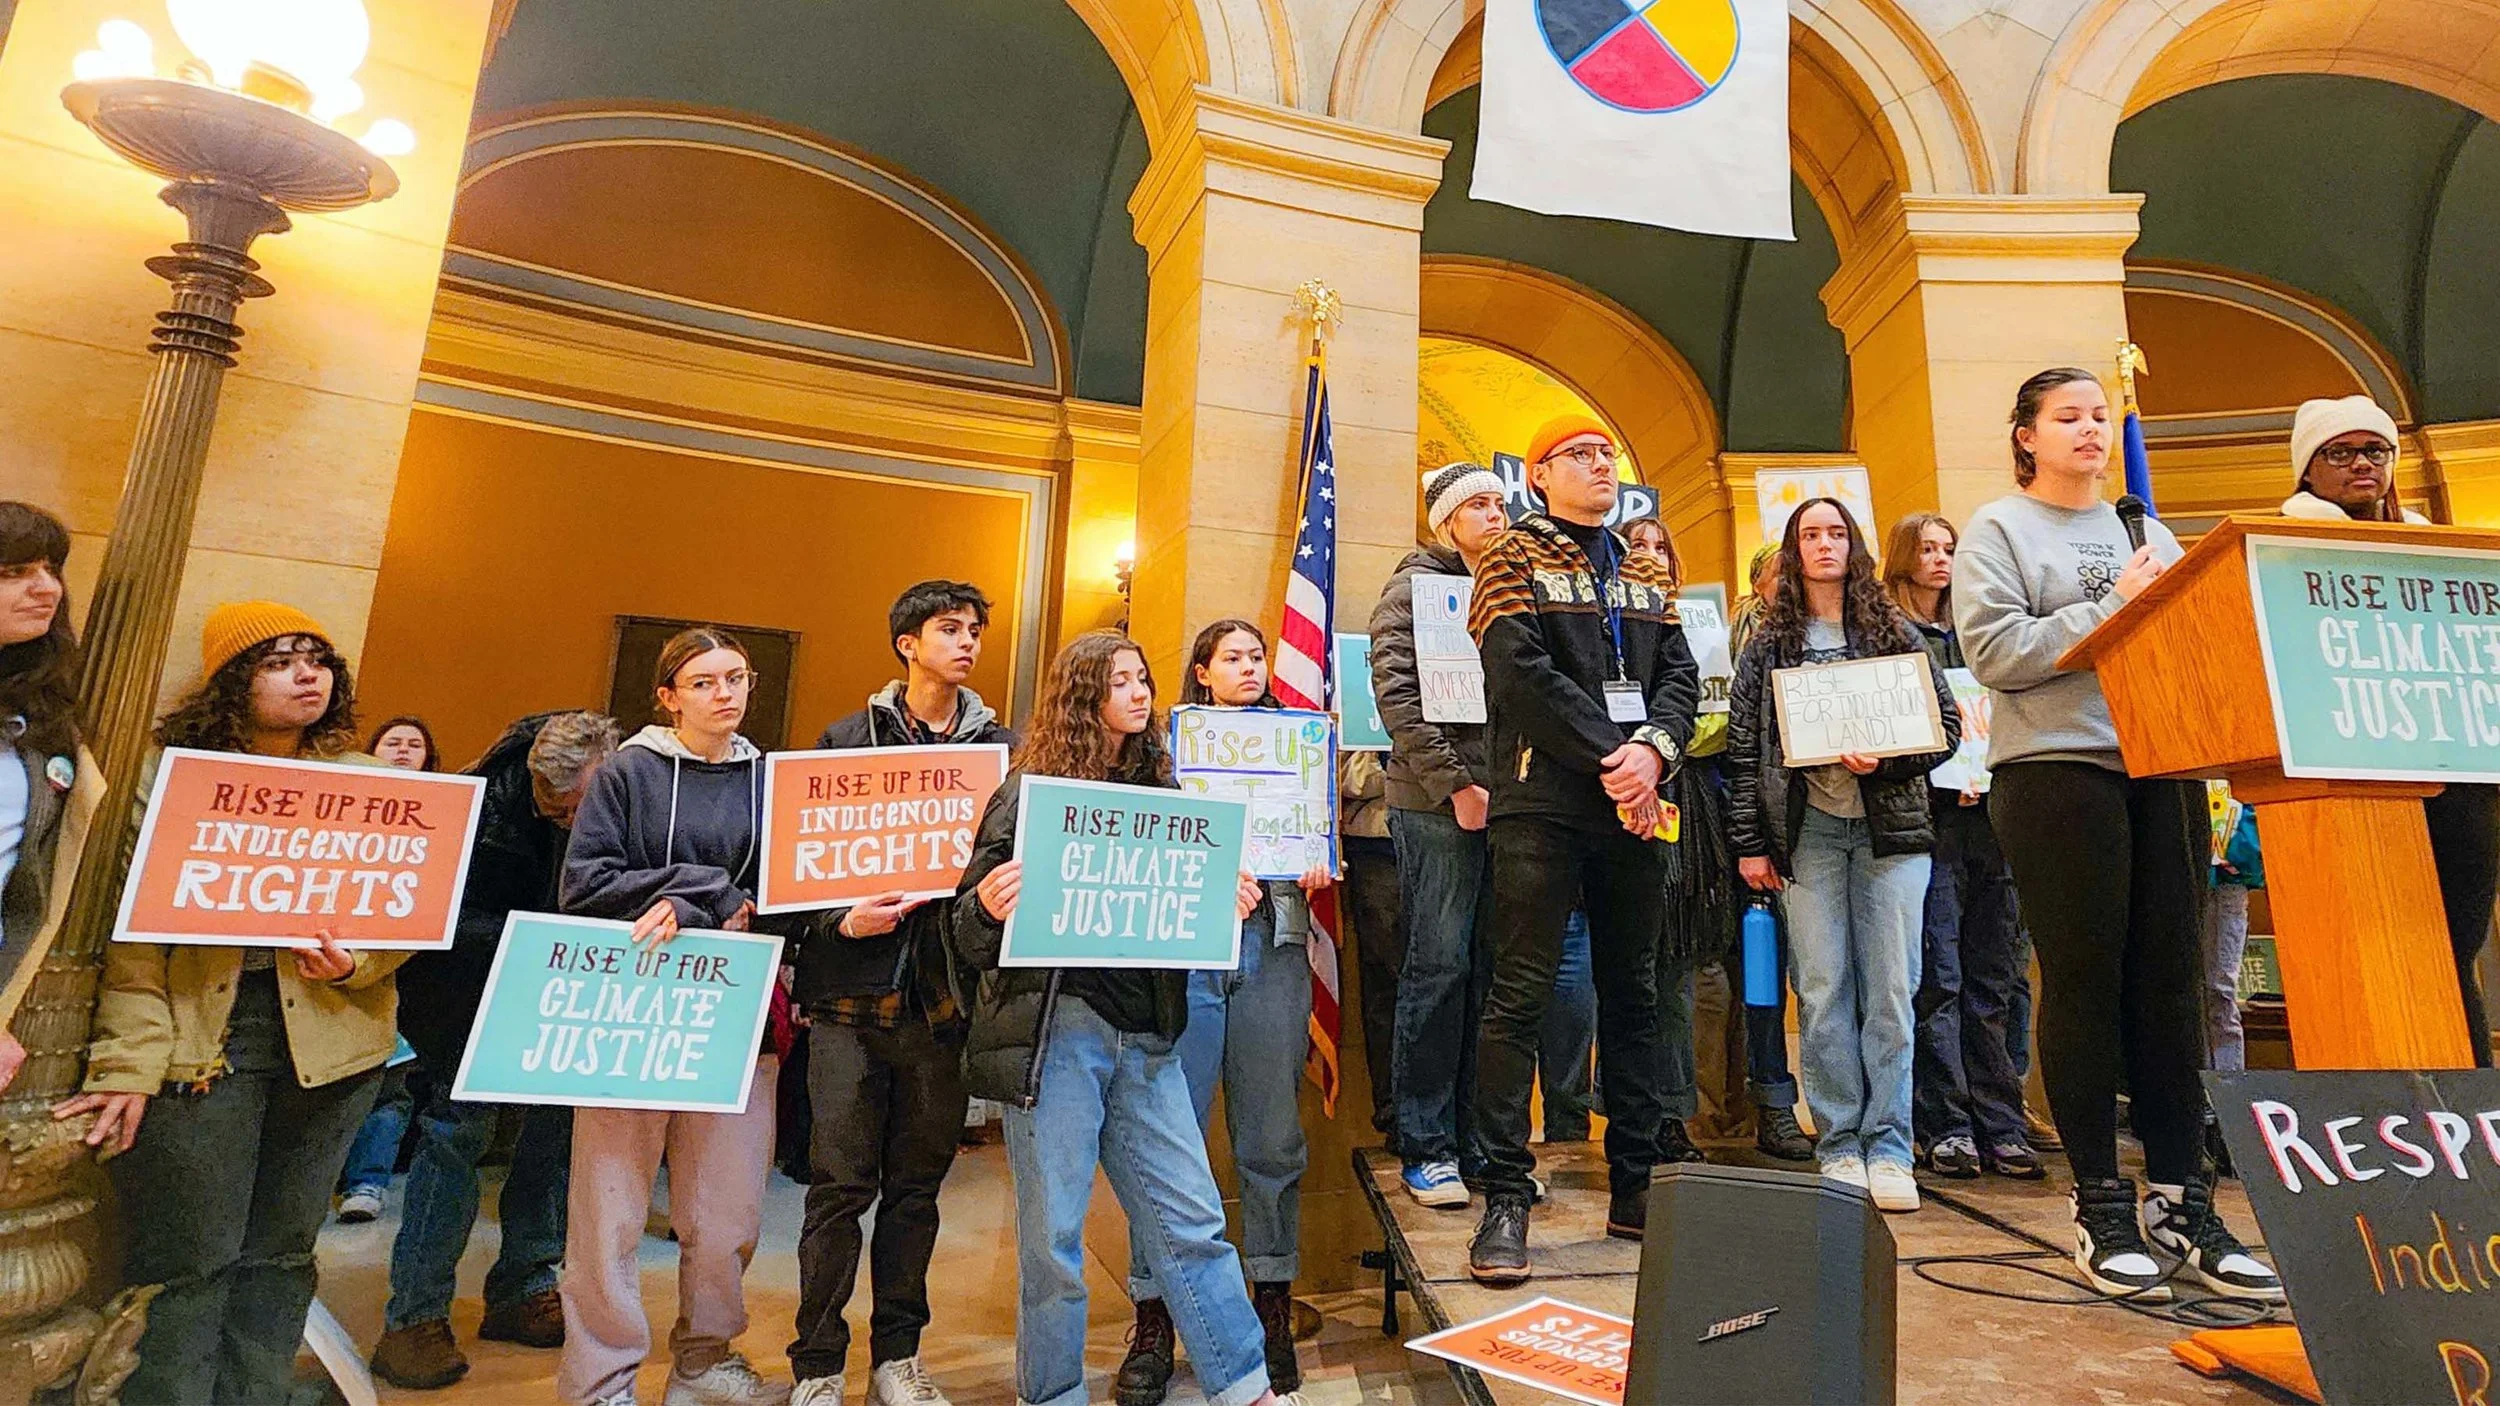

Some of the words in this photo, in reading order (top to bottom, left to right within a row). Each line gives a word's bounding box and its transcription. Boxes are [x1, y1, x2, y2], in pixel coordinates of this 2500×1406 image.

[2395, 577, 2435, 612] UP
[2442, 580, 2500, 616] FOR
[1873, 659, 1917, 692] UP
[1787, 698, 1833, 724] FOR
[2332, 676, 2500, 747] JUSTIC
[1825, 717, 1898, 750] LAND!
[883, 771, 911, 794] UP
[918, 768, 978, 793] FOR
[315, 792, 355, 821] UP
[362, 797, 436, 830] FOR
[1133, 812, 1161, 840] UP
[1167, 815, 1221, 847] FOR
[794, 828, 974, 882] RIGHTS
[172, 859, 419, 918] RIGHTS
[635, 951, 671, 978] UP
[675, 952, 741, 987] FOR
[1698, 1307, 1779, 1341] BOSE
[1479, 1339, 1537, 1364] FOR
[1534, 1360, 1578, 1376] UP
